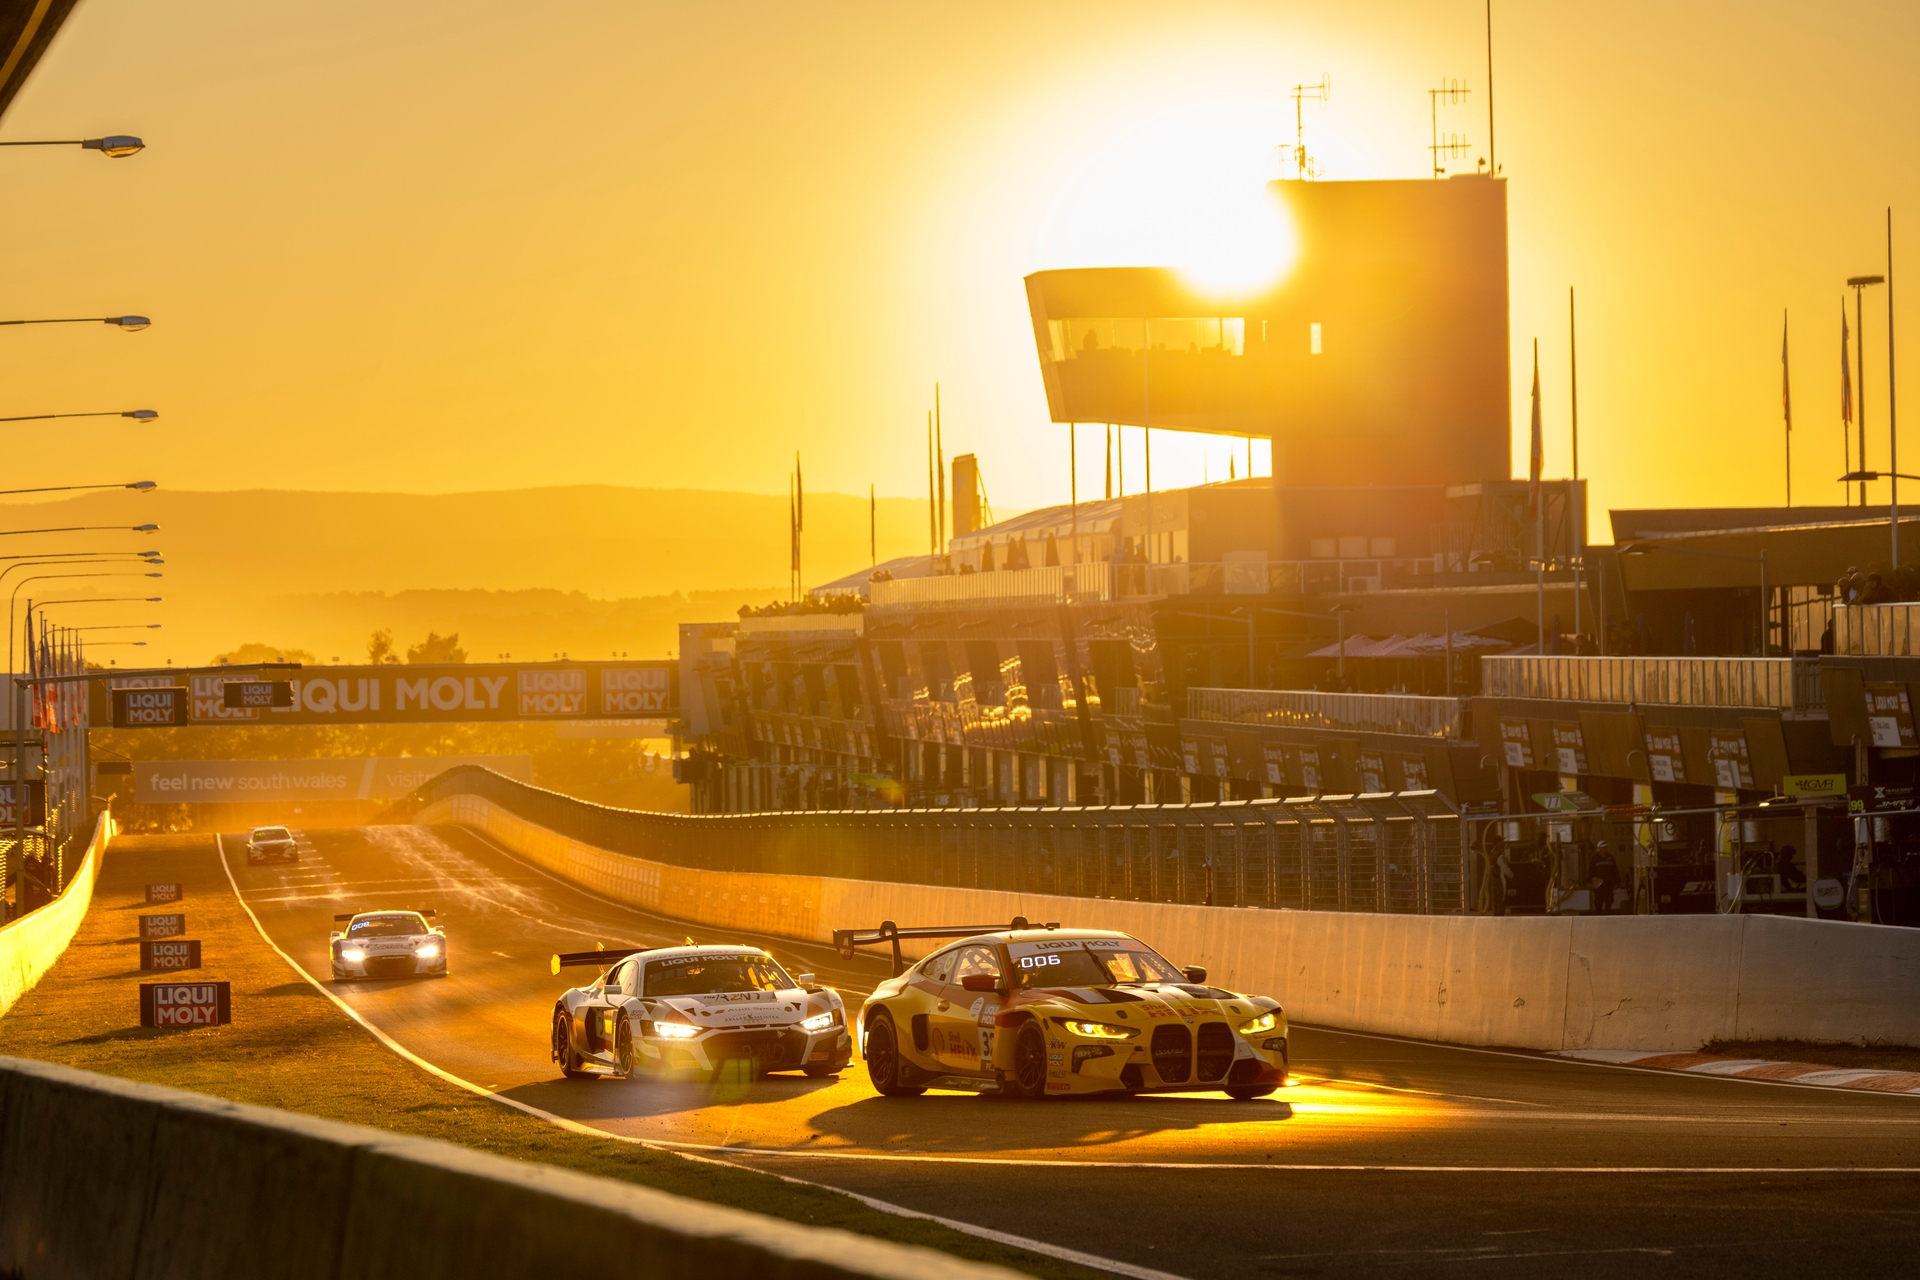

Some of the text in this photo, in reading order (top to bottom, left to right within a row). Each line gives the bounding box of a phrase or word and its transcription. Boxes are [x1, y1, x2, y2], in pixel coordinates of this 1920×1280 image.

[522, 672, 582, 692] LIQUI
[605, 671, 666, 690] LIQUI
[242, 685, 272, 696] LIQUI
[395, 676, 509, 712] MOLY
[129, 693, 172, 708] LIQUI
[242, 695, 272, 705] MOLY
[522, 693, 585, 713] MOLY
[605, 692, 667, 711] MOLY
[129, 709, 172, 722] MOLY
[150, 772, 188, 791] feel
[191, 777, 234, 790] new
[238, 772, 290, 790] south
[292, 772, 346, 788] wales
[1546, 796, 1560, 808] 77
[1850, 800, 1864, 810] 99
[147, 916, 177, 926] LIQUI
[148, 926, 177, 936] MOLY
[153, 945, 188, 956] LIQUI
[1035, 941, 1078, 950] LIQUI
[154, 956, 188, 968] MOLY
[661, 956, 700, 967] LIQUI
[740, 954, 769, 964] 777
[1020, 954, 1060, 968] 006
[158, 986, 214, 1005] LIQUI
[158, 1006, 215, 1024] MOLY
[948, 1031, 962, 1043] Shell
[950, 1043, 979, 1062] HELIX
[1050, 1042, 1067, 1050] KW
